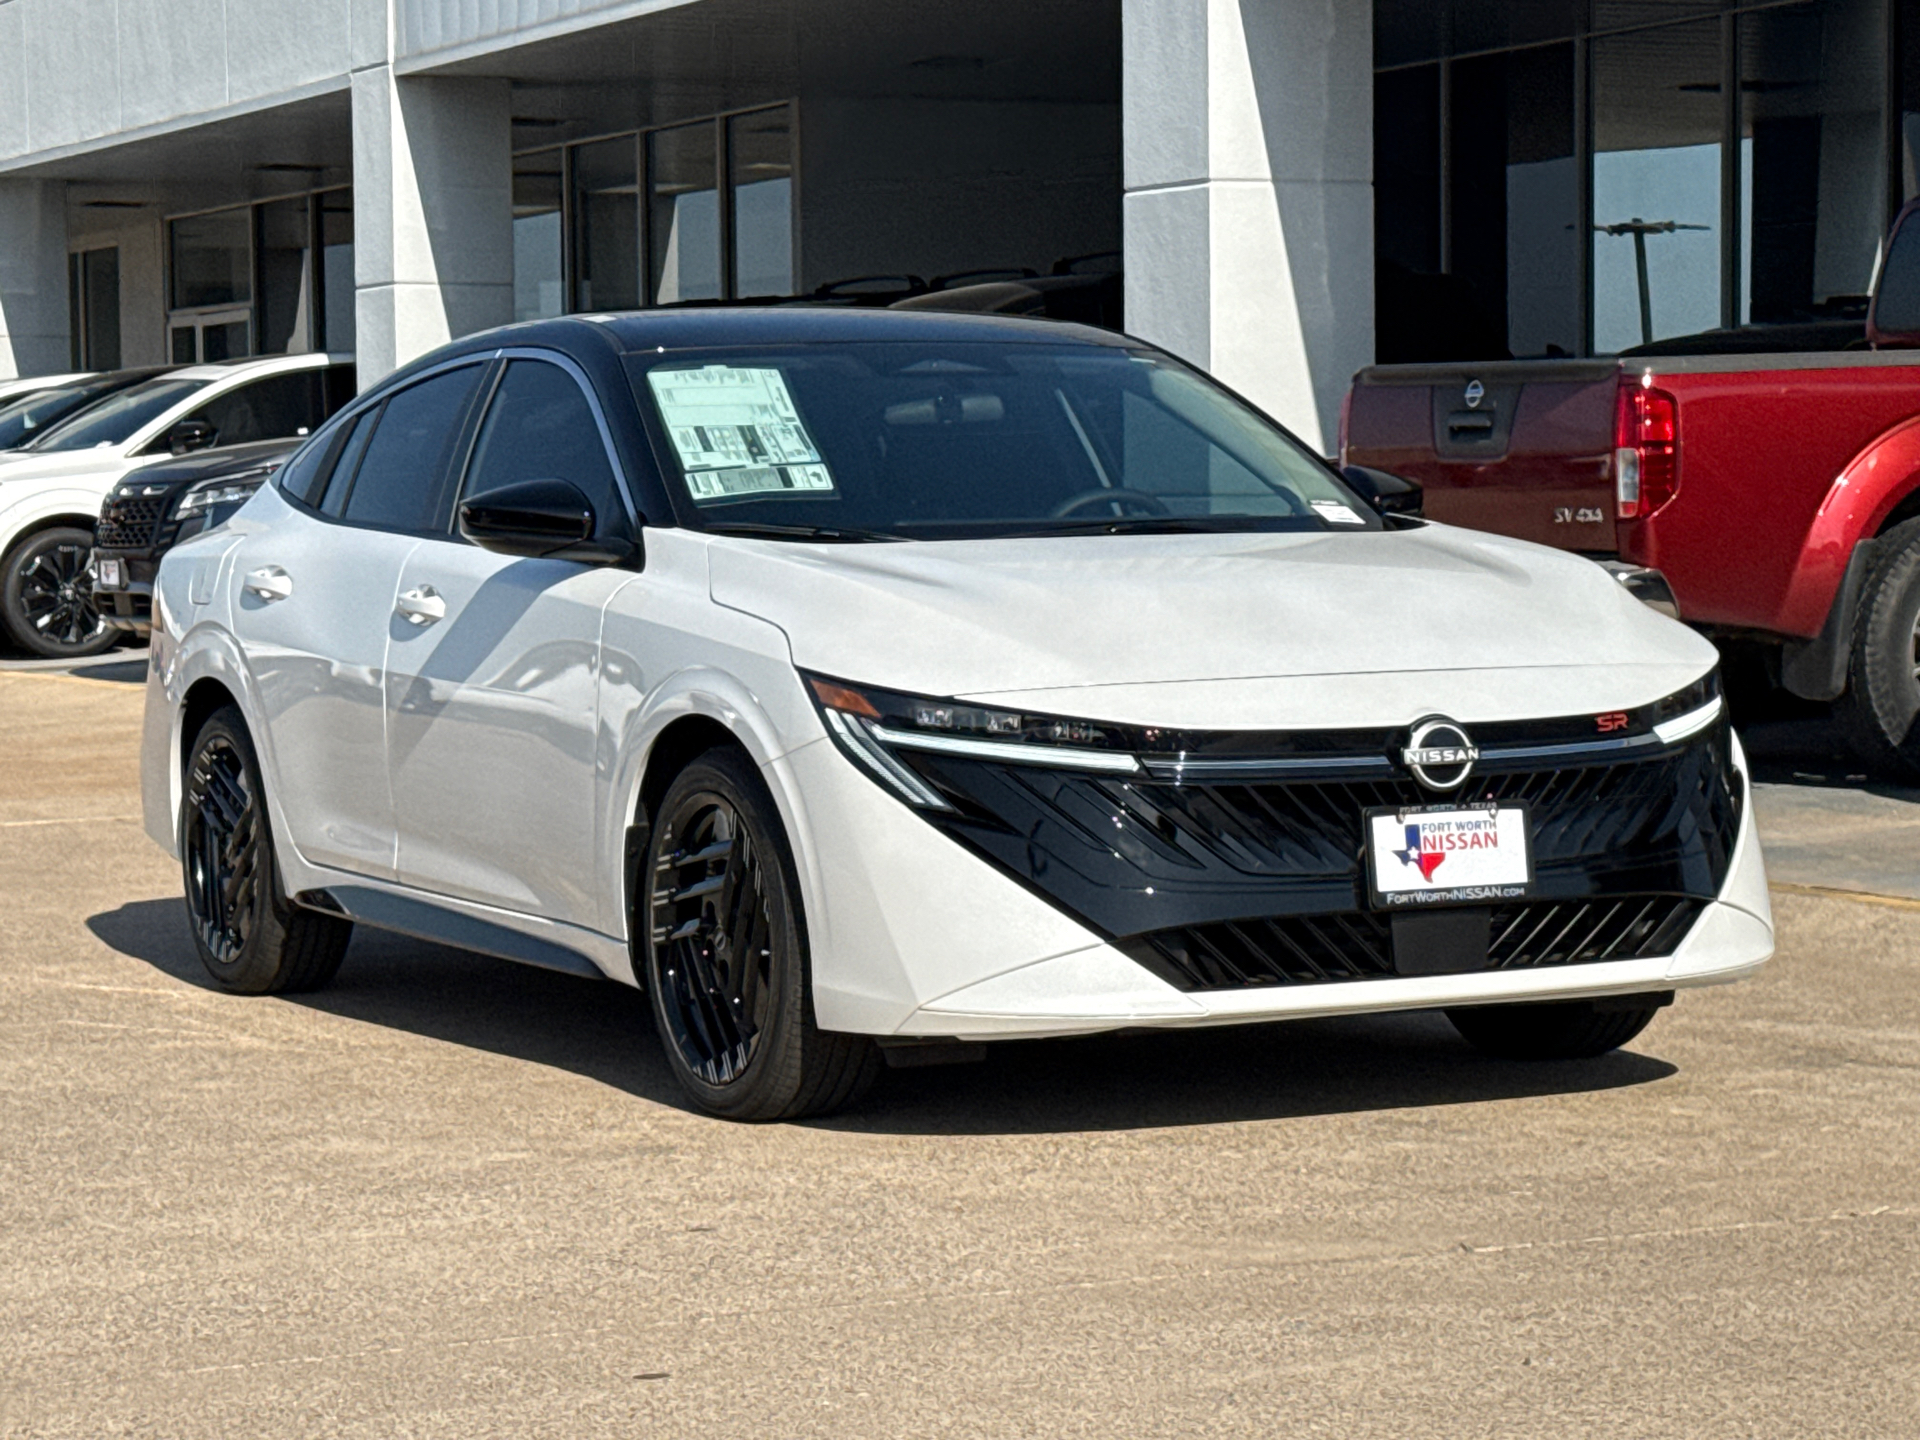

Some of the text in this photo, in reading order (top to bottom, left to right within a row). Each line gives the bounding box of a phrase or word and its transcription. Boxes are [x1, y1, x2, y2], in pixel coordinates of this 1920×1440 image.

[1555, 507, 1573, 523] SV
[1597, 713, 1628, 732] SR
[1405, 748, 1479, 763] NISSAN
[1400, 806, 1422, 814] FORT
[1470, 802, 1497, 810] TEXAS
[1422, 820, 1497, 833] FORT WORTH
[1422, 831, 1498, 851] NISSAN
